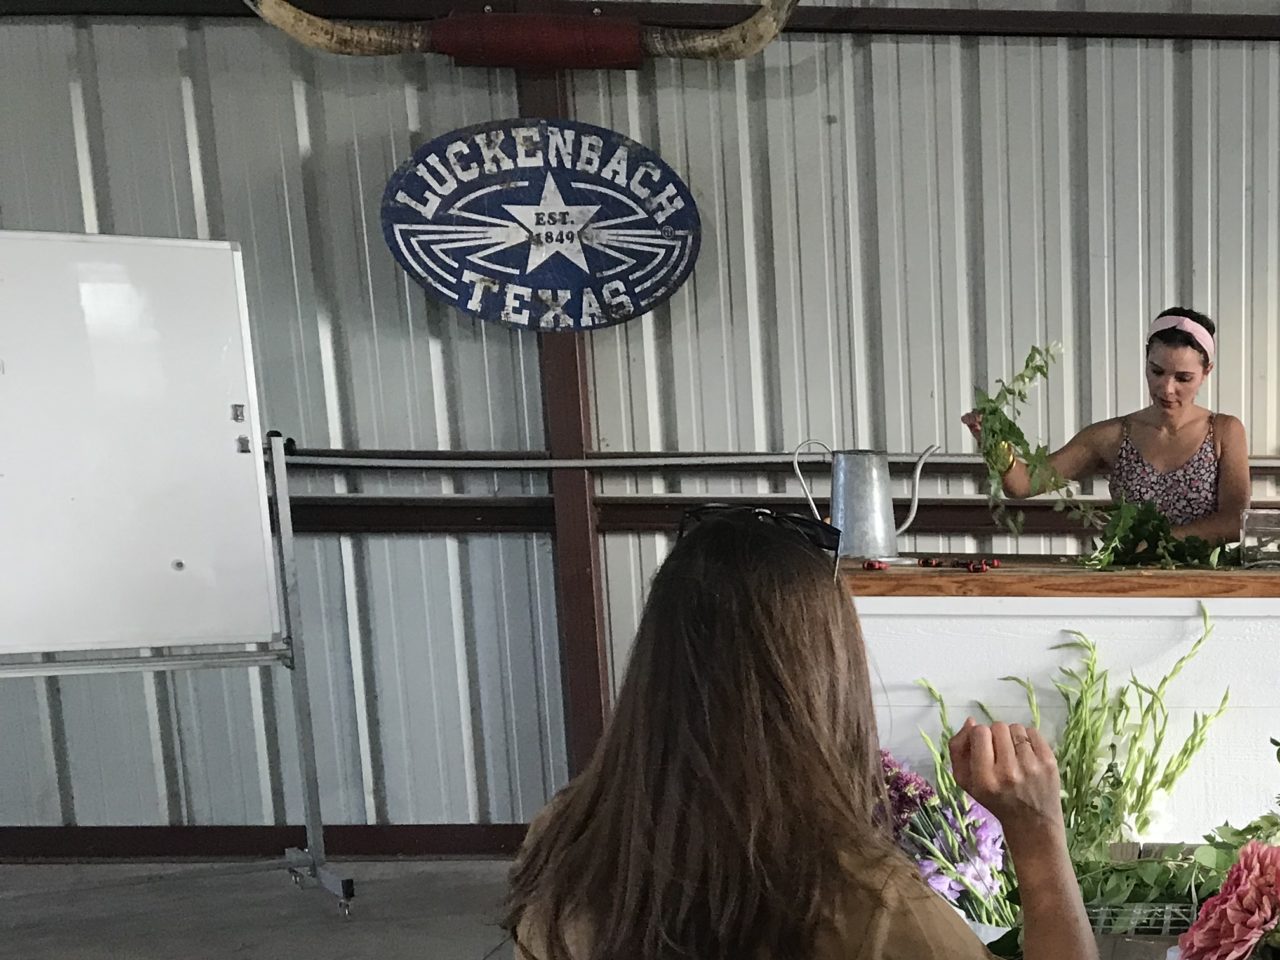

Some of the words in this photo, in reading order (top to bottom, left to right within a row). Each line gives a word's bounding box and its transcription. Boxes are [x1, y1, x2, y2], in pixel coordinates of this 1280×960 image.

[395, 126, 685, 224] LUCKENBACH
[534, 211, 575, 226] EST.
[533, 230, 575, 247] 1849
[461, 269, 634, 328] TEXAS
